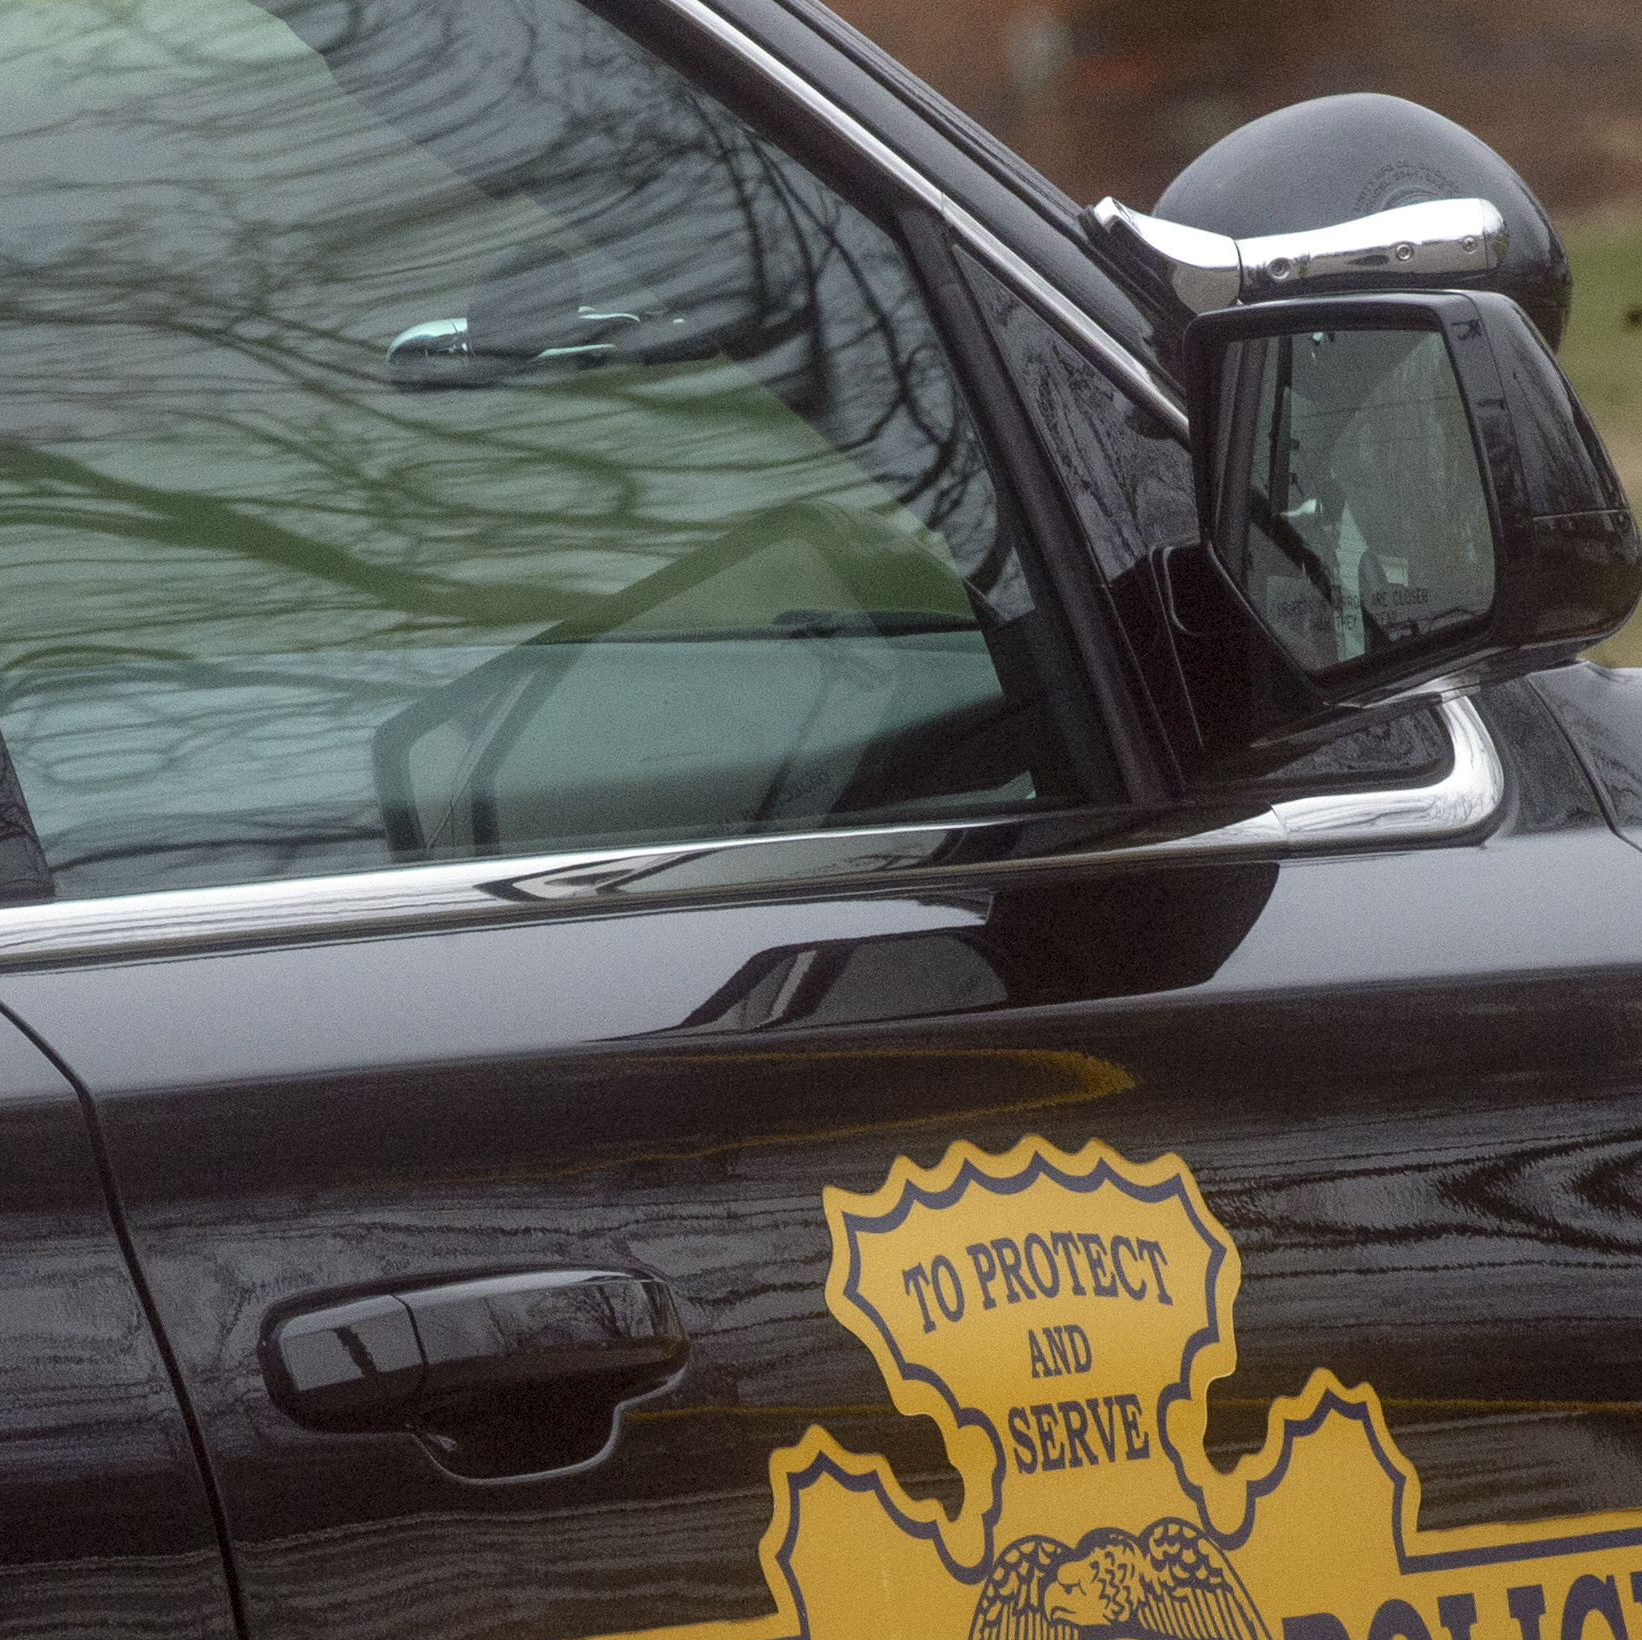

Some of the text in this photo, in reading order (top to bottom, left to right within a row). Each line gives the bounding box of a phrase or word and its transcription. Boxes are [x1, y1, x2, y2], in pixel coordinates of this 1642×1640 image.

[902, 1230, 1174, 1334] TO PROTECT
[1027, 1324, 1092, 1379] AND
[1008, 1393, 1151, 1474] SERVE
